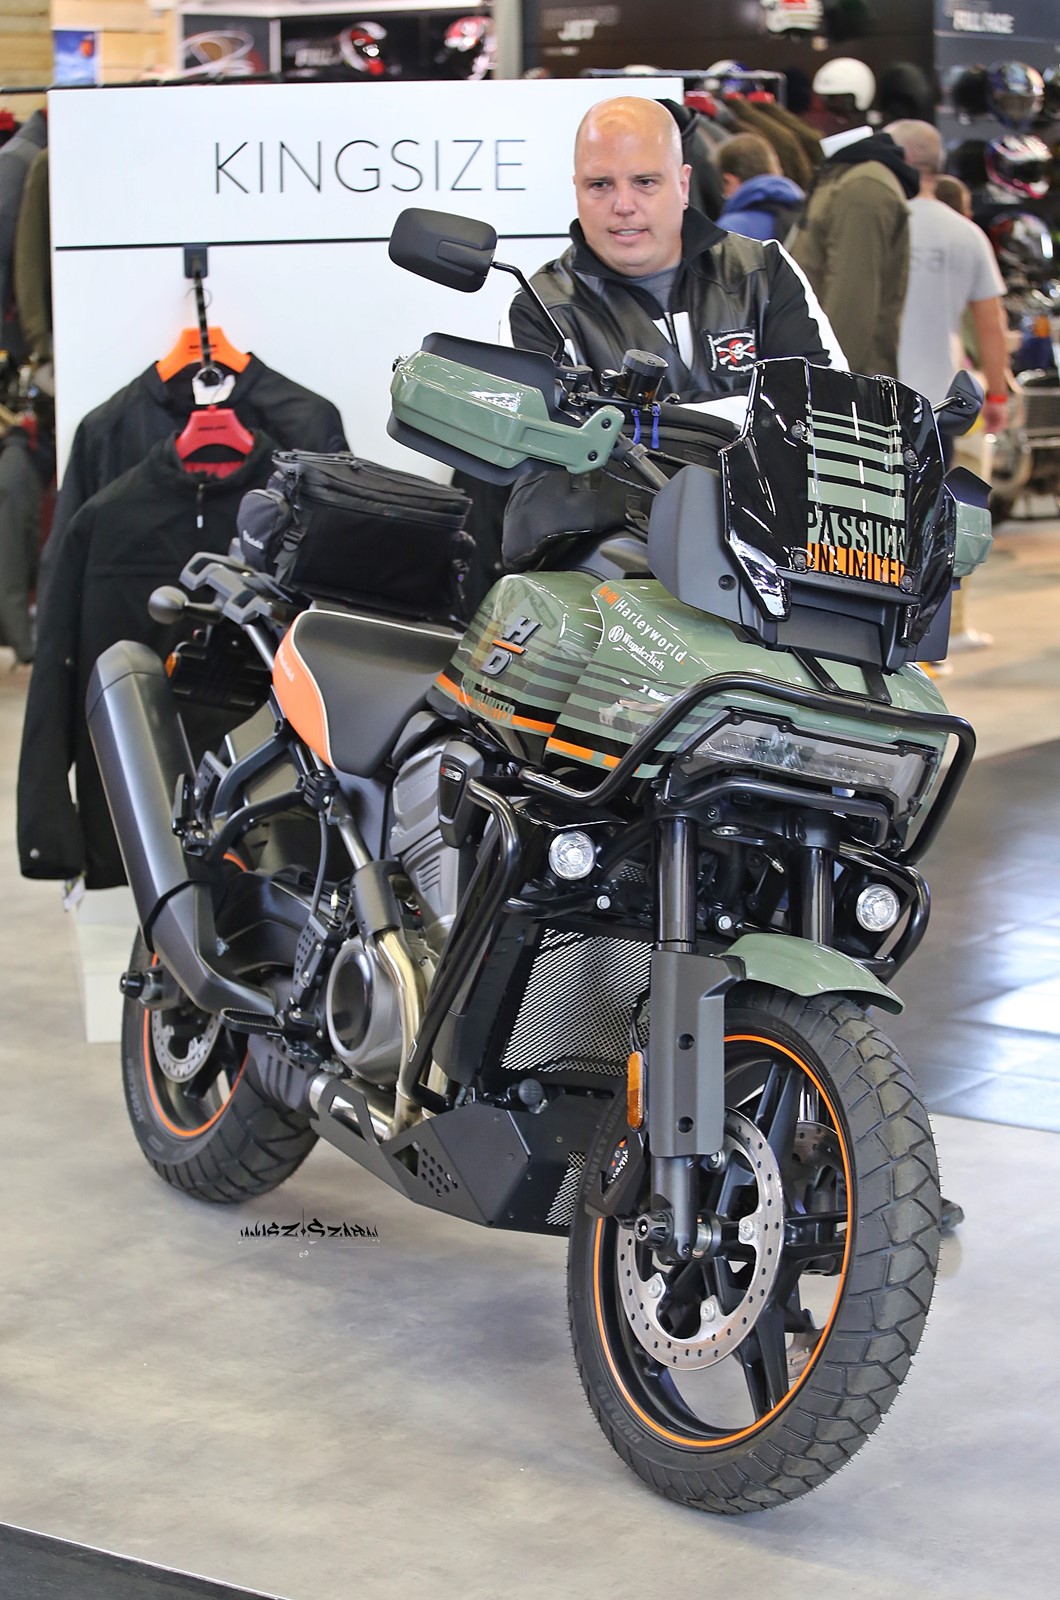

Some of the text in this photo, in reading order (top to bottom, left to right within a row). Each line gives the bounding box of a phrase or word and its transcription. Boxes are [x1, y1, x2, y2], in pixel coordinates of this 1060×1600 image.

[215, 139, 528, 194] KINGSIZE
[806, 507, 907, 563] PASSION
[621, 632, 665, 672] Wunderlich
